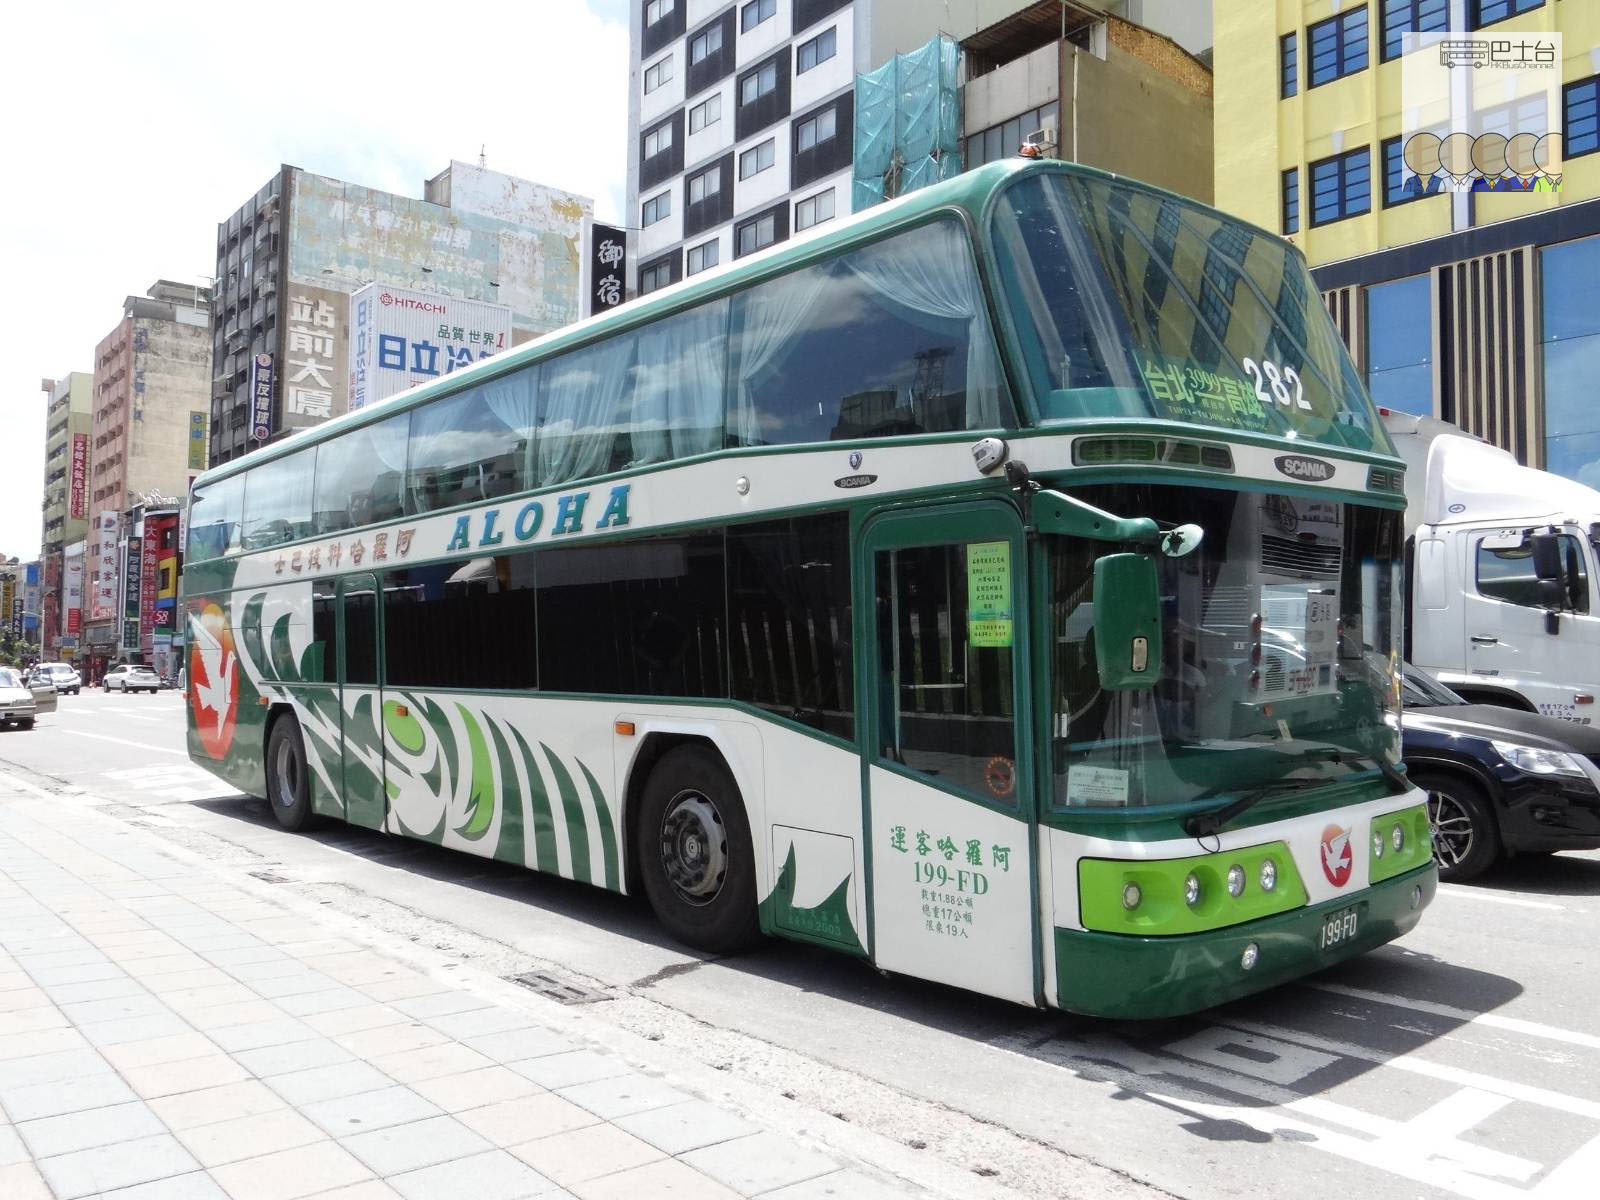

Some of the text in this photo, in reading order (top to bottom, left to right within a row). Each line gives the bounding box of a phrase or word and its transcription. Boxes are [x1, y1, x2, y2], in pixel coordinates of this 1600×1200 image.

[596, 239, 624, 306] 御宿
[395, 298, 447, 314] HITACHI
[437, 324, 465, 342] 品質
[288, 295, 336, 418] 站前大廈
[378, 333, 495, 376] 日立冷
[1243, 357, 1312, 411] 282
[839, 475, 871, 488] SCANIA
[1283, 458, 1328, 479] SCANIA
[446, 484, 632, 551] ALOHA
[913, 861, 989, 895] 199-FD
